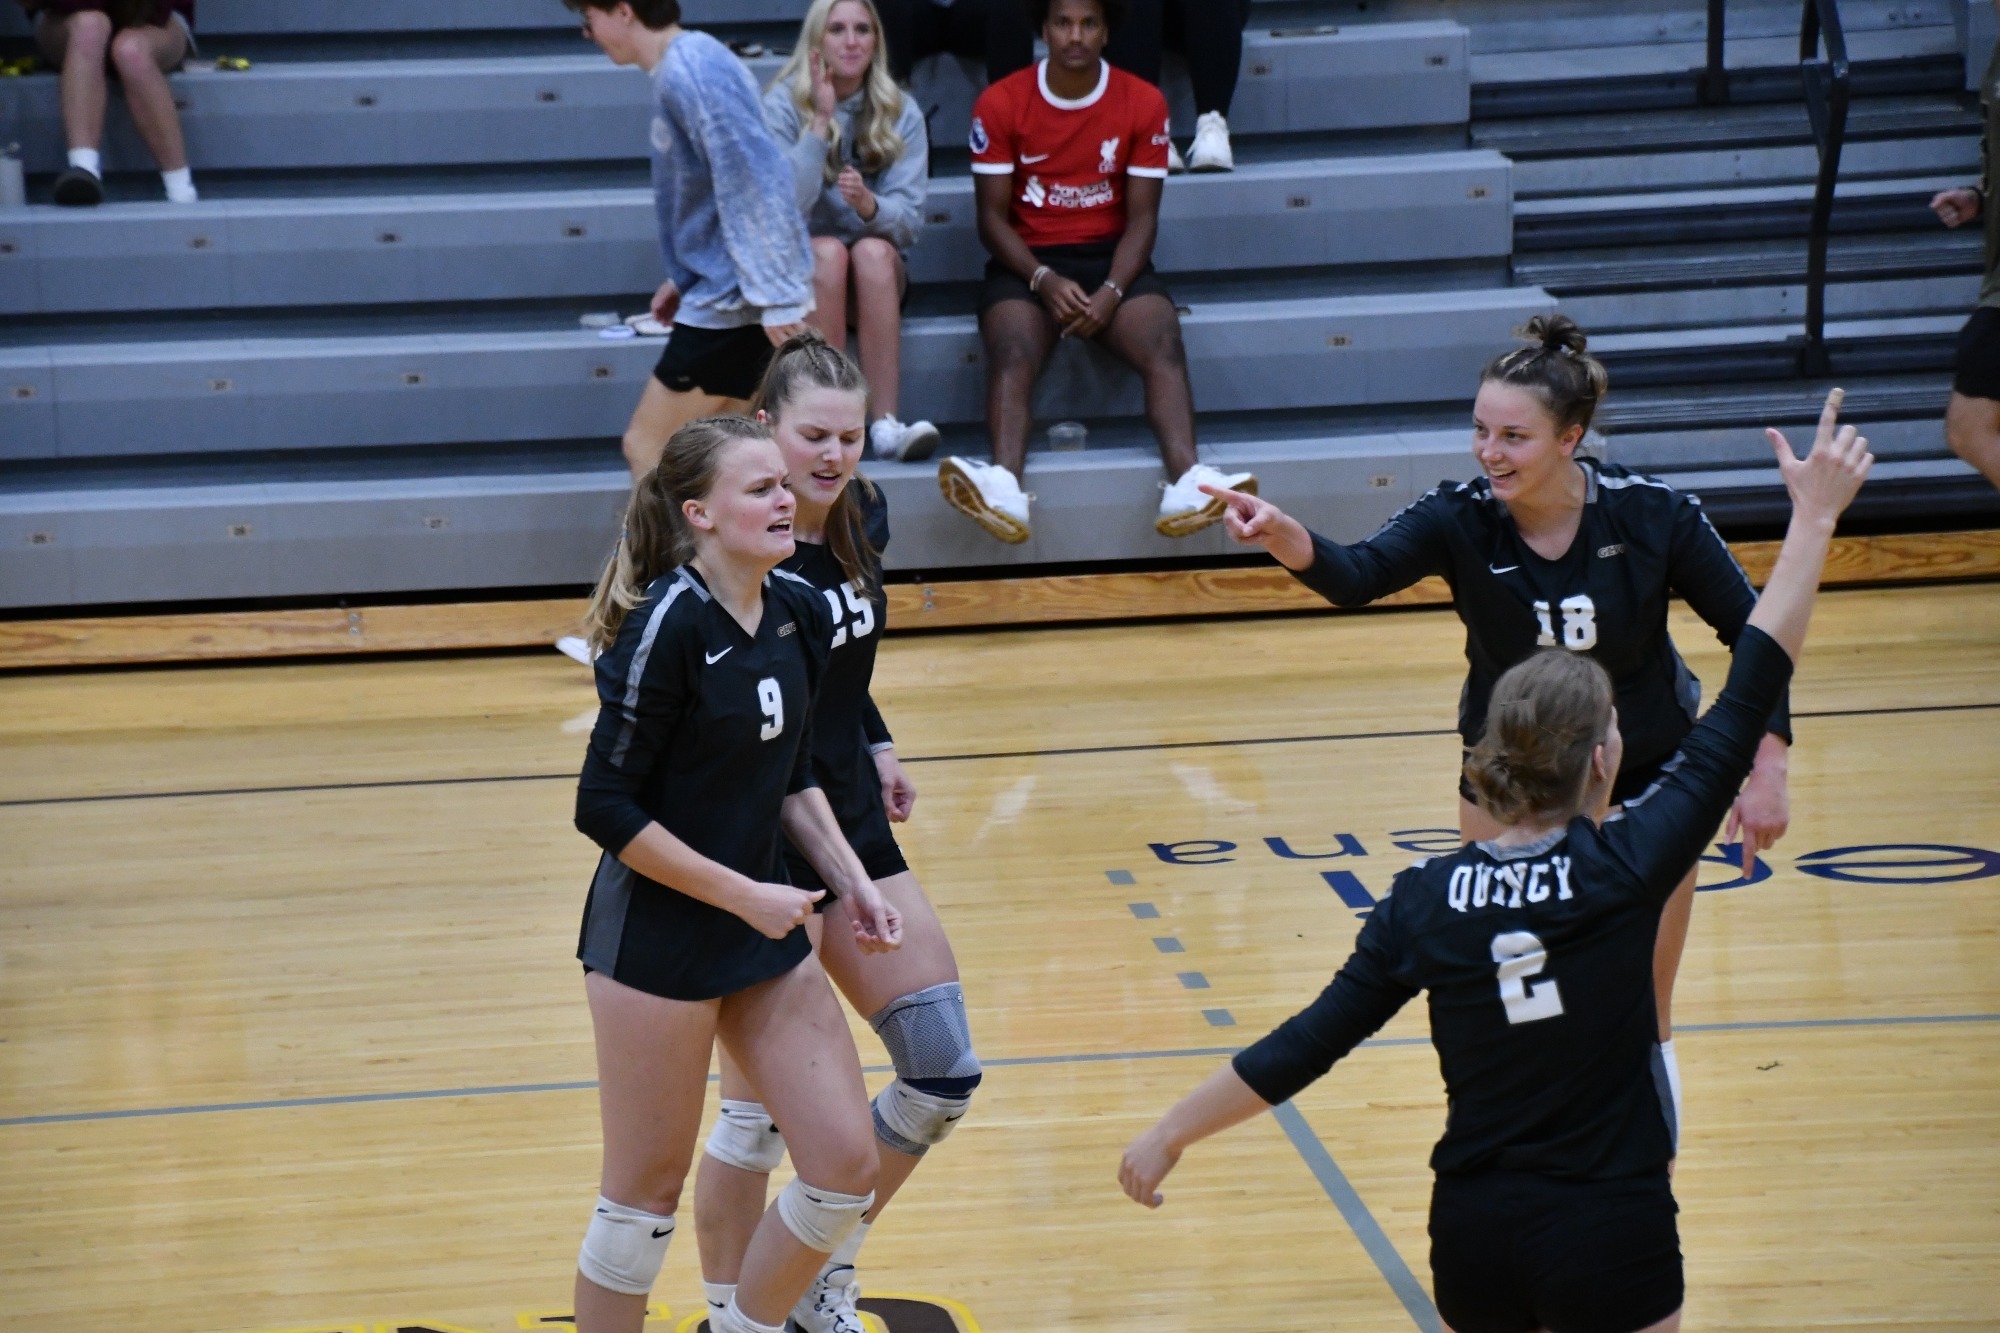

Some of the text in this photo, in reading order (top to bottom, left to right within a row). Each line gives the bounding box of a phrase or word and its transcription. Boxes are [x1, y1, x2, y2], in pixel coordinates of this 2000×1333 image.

[1533, 594, 1598, 650] 18
[757, 676, 784, 742] 9
[1447, 855, 1574, 913] QUINCY
[1490, 931, 1565, 1025] 2
